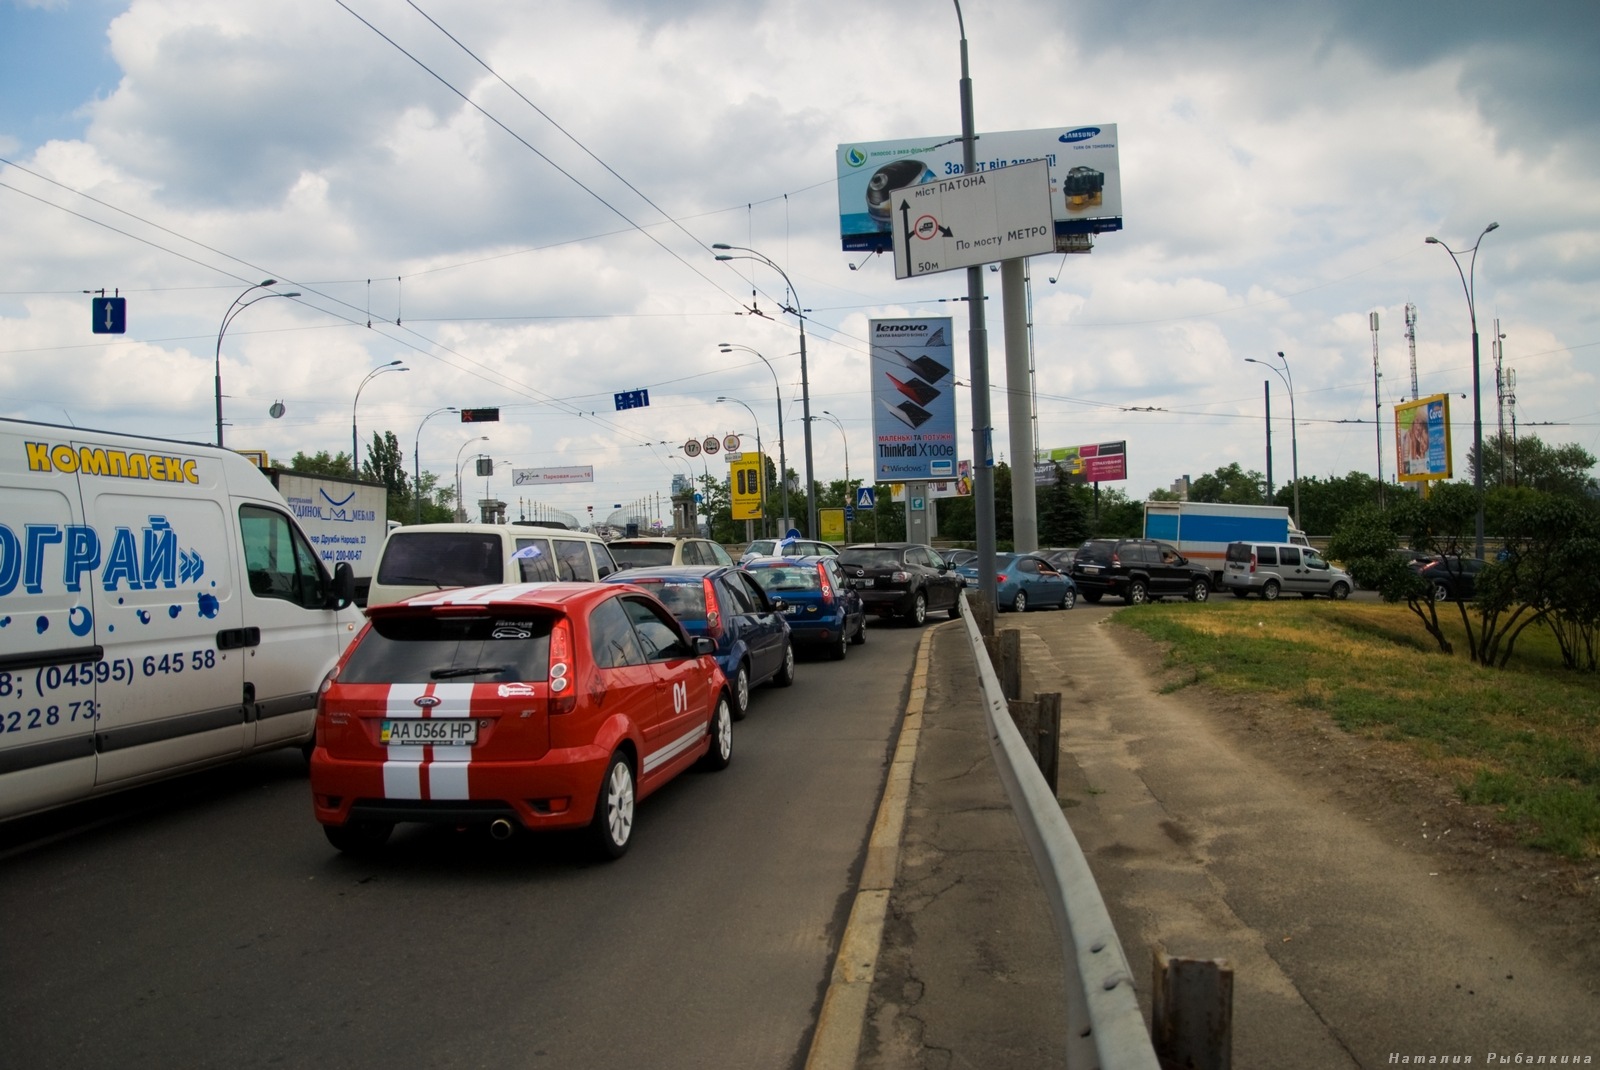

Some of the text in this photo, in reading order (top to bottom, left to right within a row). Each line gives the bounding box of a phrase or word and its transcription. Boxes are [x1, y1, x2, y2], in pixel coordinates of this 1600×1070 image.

[945, 161, 985, 175] Захст
[915, 175, 986, 198] міст ПАТОНА
[956, 226, 1047, 251] По мосту МЕТРО
[918, 261, 939, 272] 50м
[876, 323, 928, 332] lenovo
[878, 434, 913, 442] МАЛЕНЬКІ
[879, 443, 954, 458] ThinkPad X100e
[24, 441, 199, 484] КОМПЛЕКС
[890, 464, 922, 472] Windows
[352, 509, 375, 521] МЕБЛІВ
[320, 535, 340, 545] Дружби
[360, 536, 366, 544] 23
[336, 550, 362, 561] 200-00-67
[35, 658, 134, 697] (04595)
[143, 652, 184, 677] 645
[191, 649, 215, 671] 58
[673, 680, 687, 714] 01
[390, 722, 472, 738] AA 0566 HP
